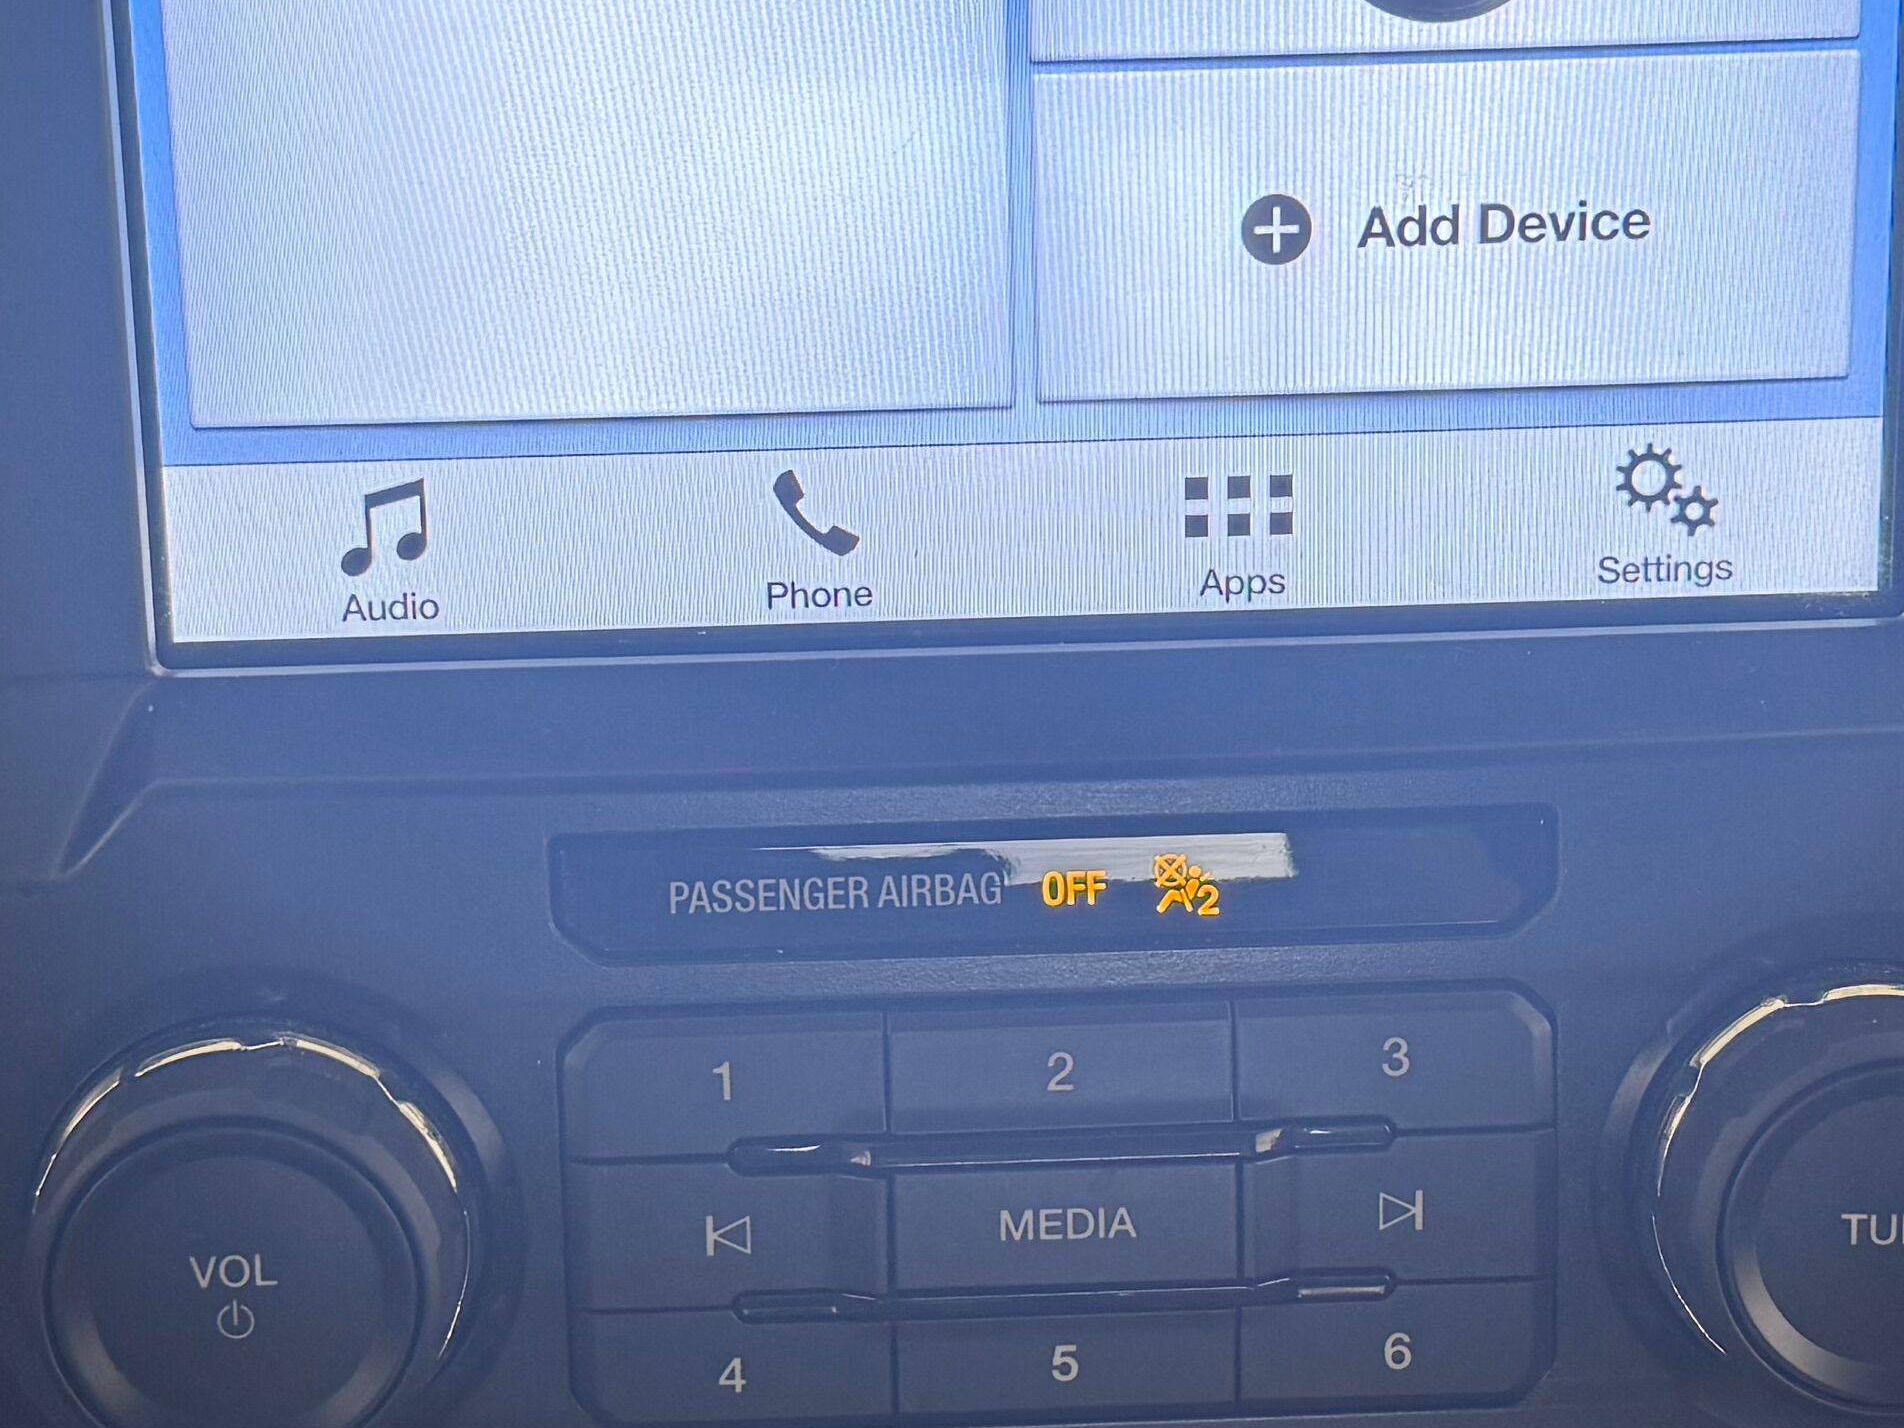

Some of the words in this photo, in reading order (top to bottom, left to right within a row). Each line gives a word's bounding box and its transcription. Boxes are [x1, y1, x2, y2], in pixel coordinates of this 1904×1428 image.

[1357, 203, 1460, 249] Add
[1479, 199, 1651, 245] Device
[1199, 568, 1287, 604] Apps
[1597, 553, 1734, 588] Settings
[341, 592, 440, 623] Audio
[765, 580, 874, 610] Phone
[669, 876, 870, 915] PASSENGER
[876, 872, 1003, 910] AIRBAG
[1040, 870, 1108, 909] OFF
[1045, 1051, 1076, 1092] 2
[1381, 1036, 1411, 1077] 3
[711, 1061, 733, 1101] 1
[998, 1206, 1138, 1243] MEDIA
[189, 1256, 279, 1292] VOL
[1050, 1343, 1080, 1383] 5
[1383, 1332, 1413, 1371] 6
[717, 1357, 747, 1394] 4
